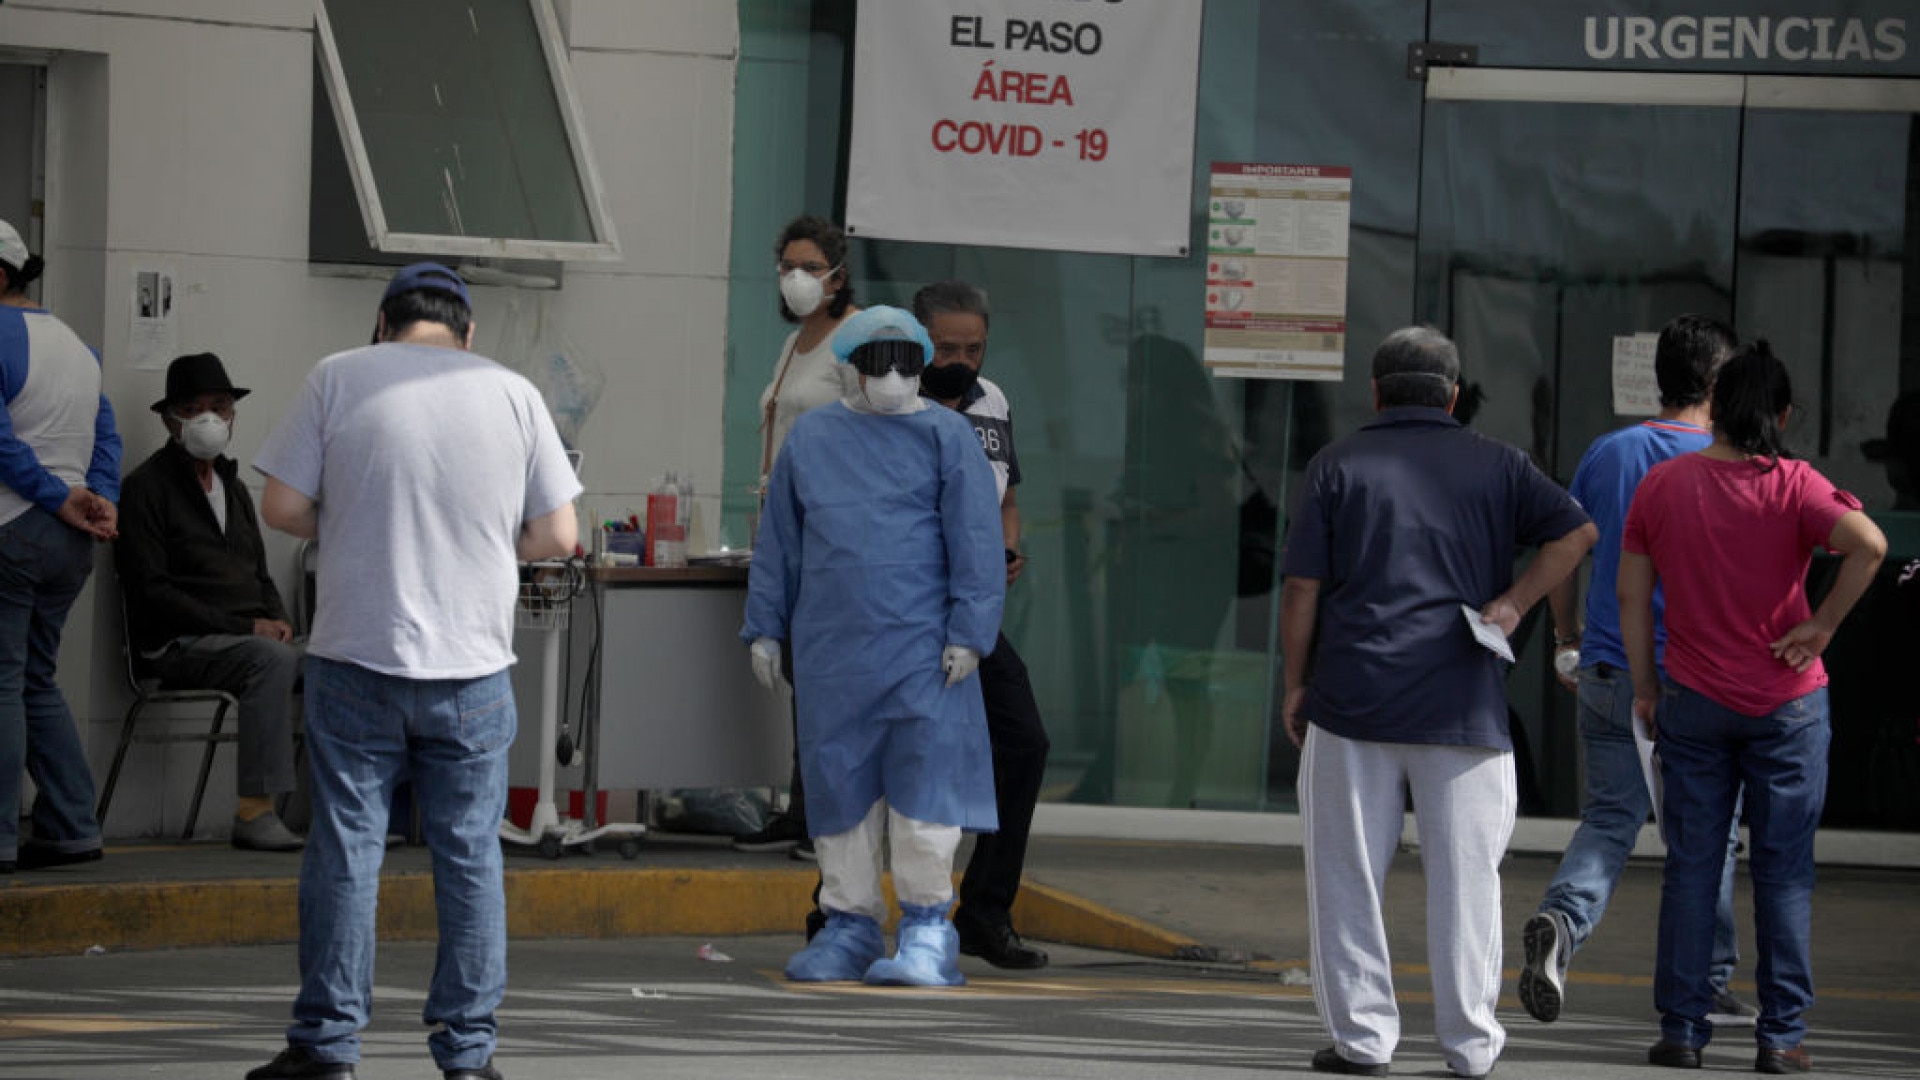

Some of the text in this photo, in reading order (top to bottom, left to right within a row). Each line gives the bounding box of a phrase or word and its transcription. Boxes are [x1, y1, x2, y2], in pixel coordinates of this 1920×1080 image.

[950, 15, 1103, 56] EL PASO
[1584, 16, 1907, 61] URGENCIAS
[972, 60, 1074, 106] ÁREA
[931, 119, 1044, 157] COVID
[1074, 128, 1109, 162] 19
[1242, 164, 1321, 177] IMPORTANTE
